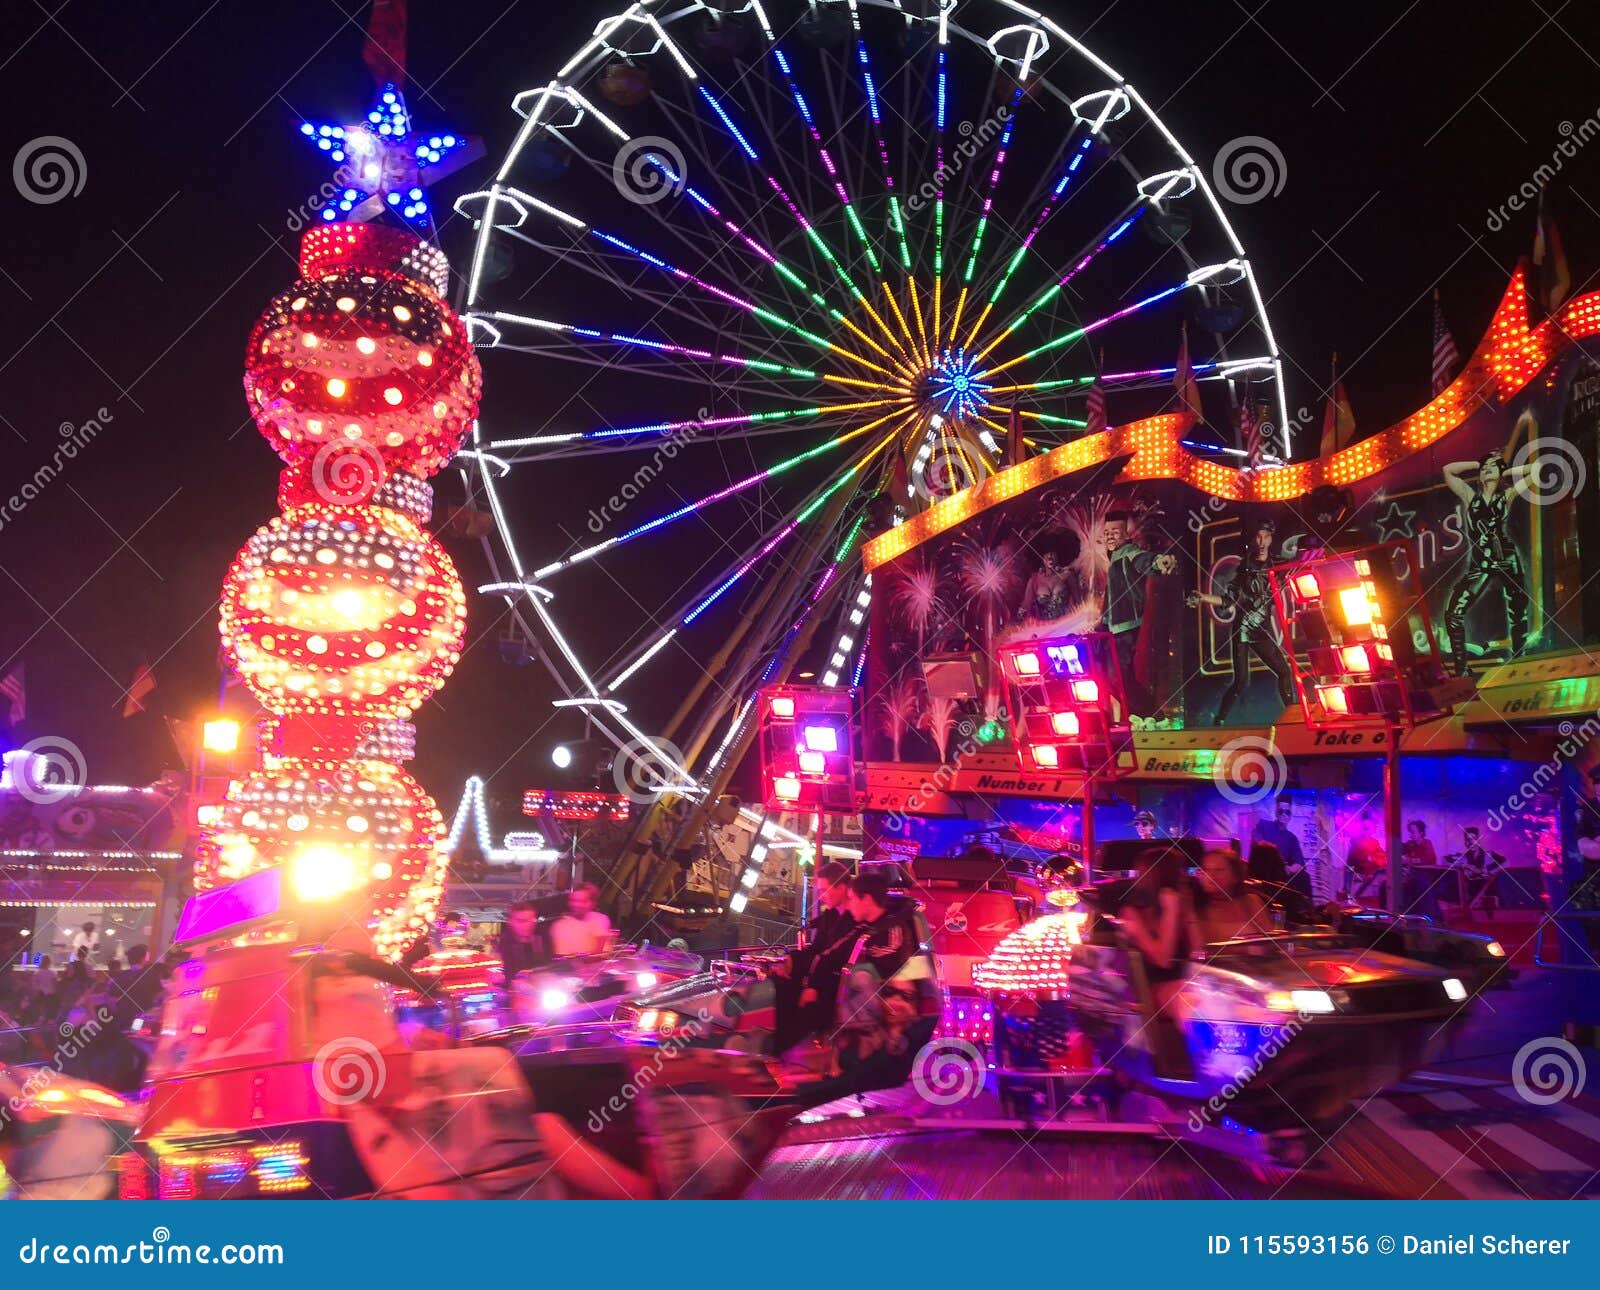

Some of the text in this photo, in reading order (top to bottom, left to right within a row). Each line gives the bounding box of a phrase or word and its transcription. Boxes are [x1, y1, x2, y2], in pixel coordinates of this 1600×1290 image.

[1313, 730, 1363, 745] Take
[976, 775, 1063, 792] Number 1
